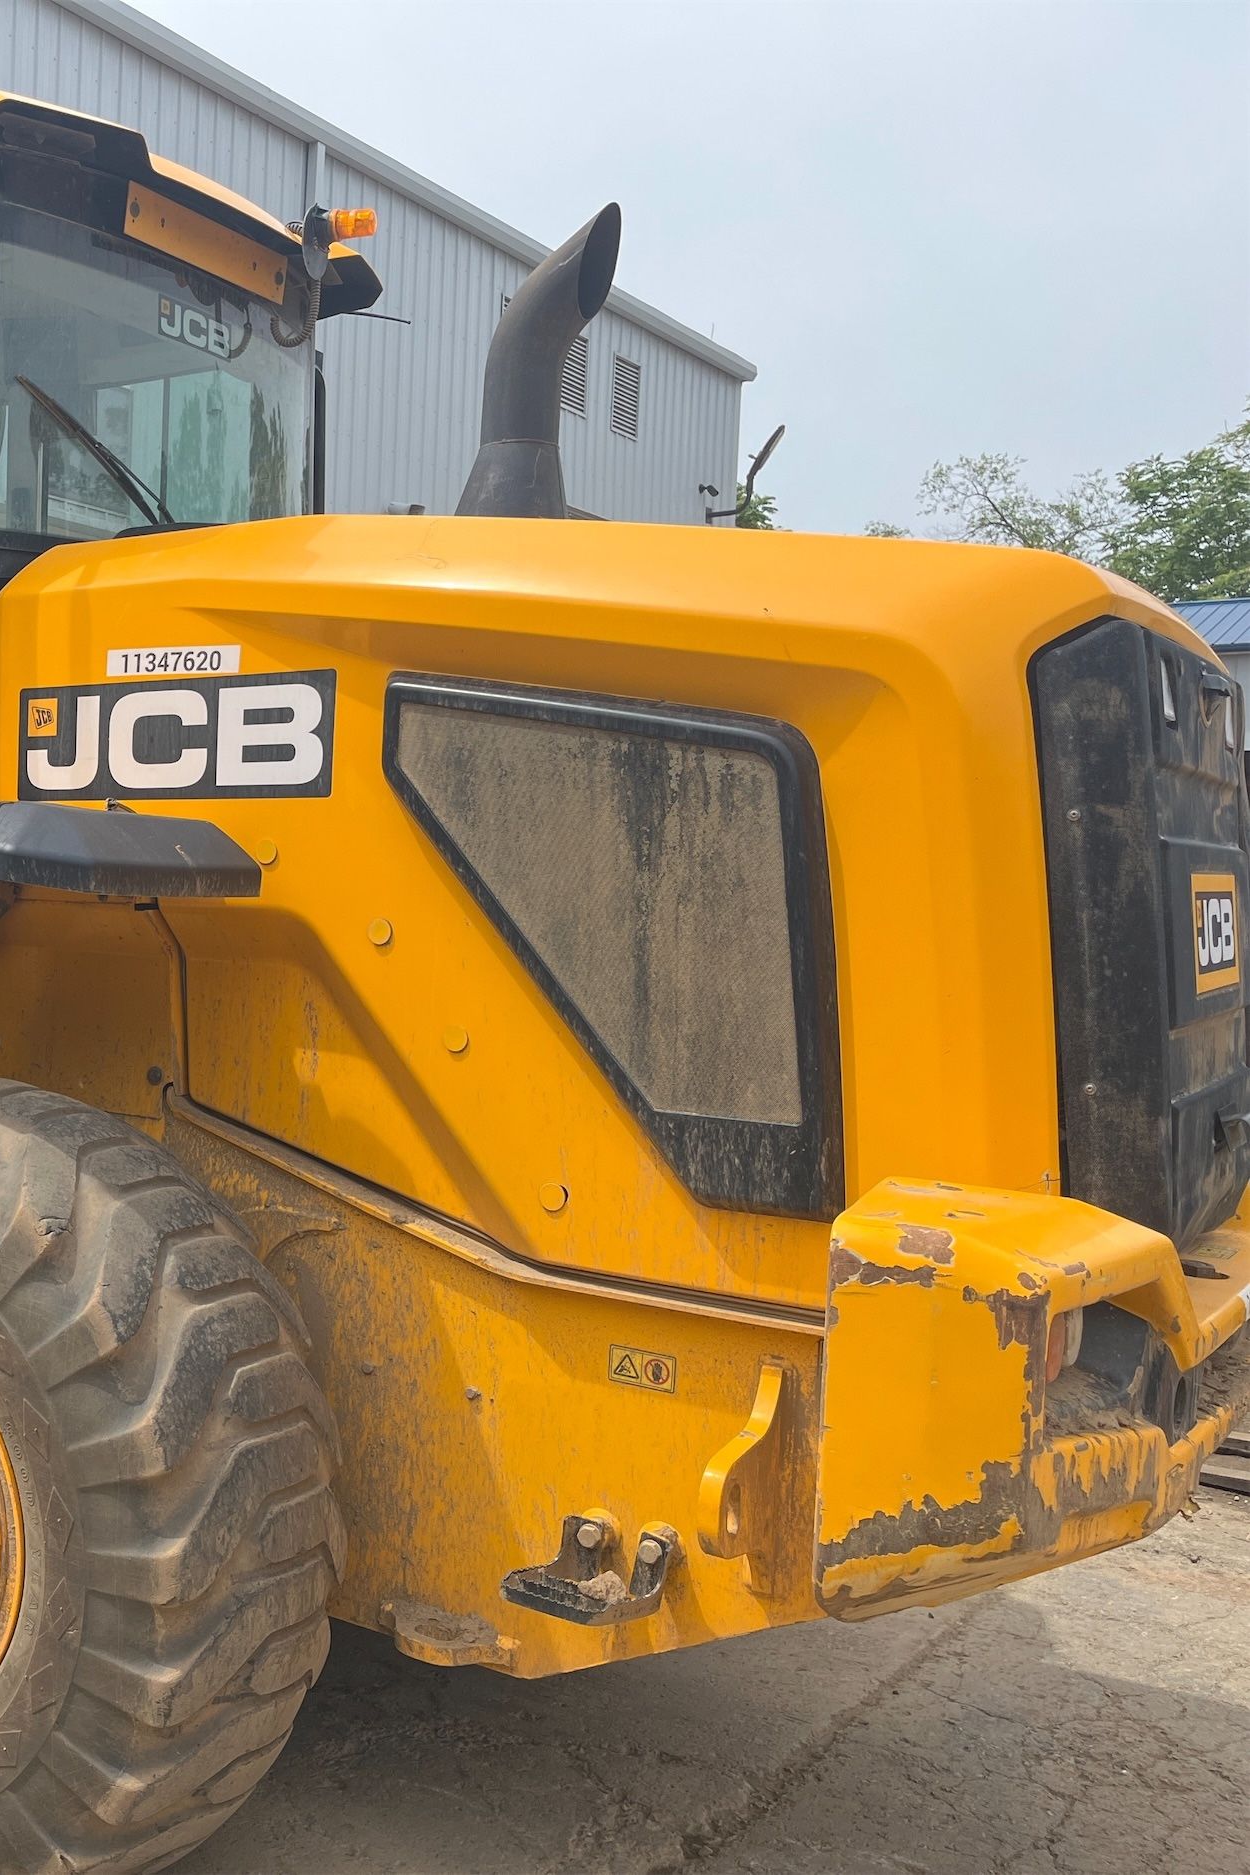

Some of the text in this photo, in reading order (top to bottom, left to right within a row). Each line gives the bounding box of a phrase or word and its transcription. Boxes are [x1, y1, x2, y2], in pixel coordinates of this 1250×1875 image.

[160, 303, 230, 358] JCB
[120, 649, 222, 674] 11347620
[26, 683, 324, 791] JCB
[34, 708, 53, 727] JCB
[1197, 898, 1235, 967] JCB
